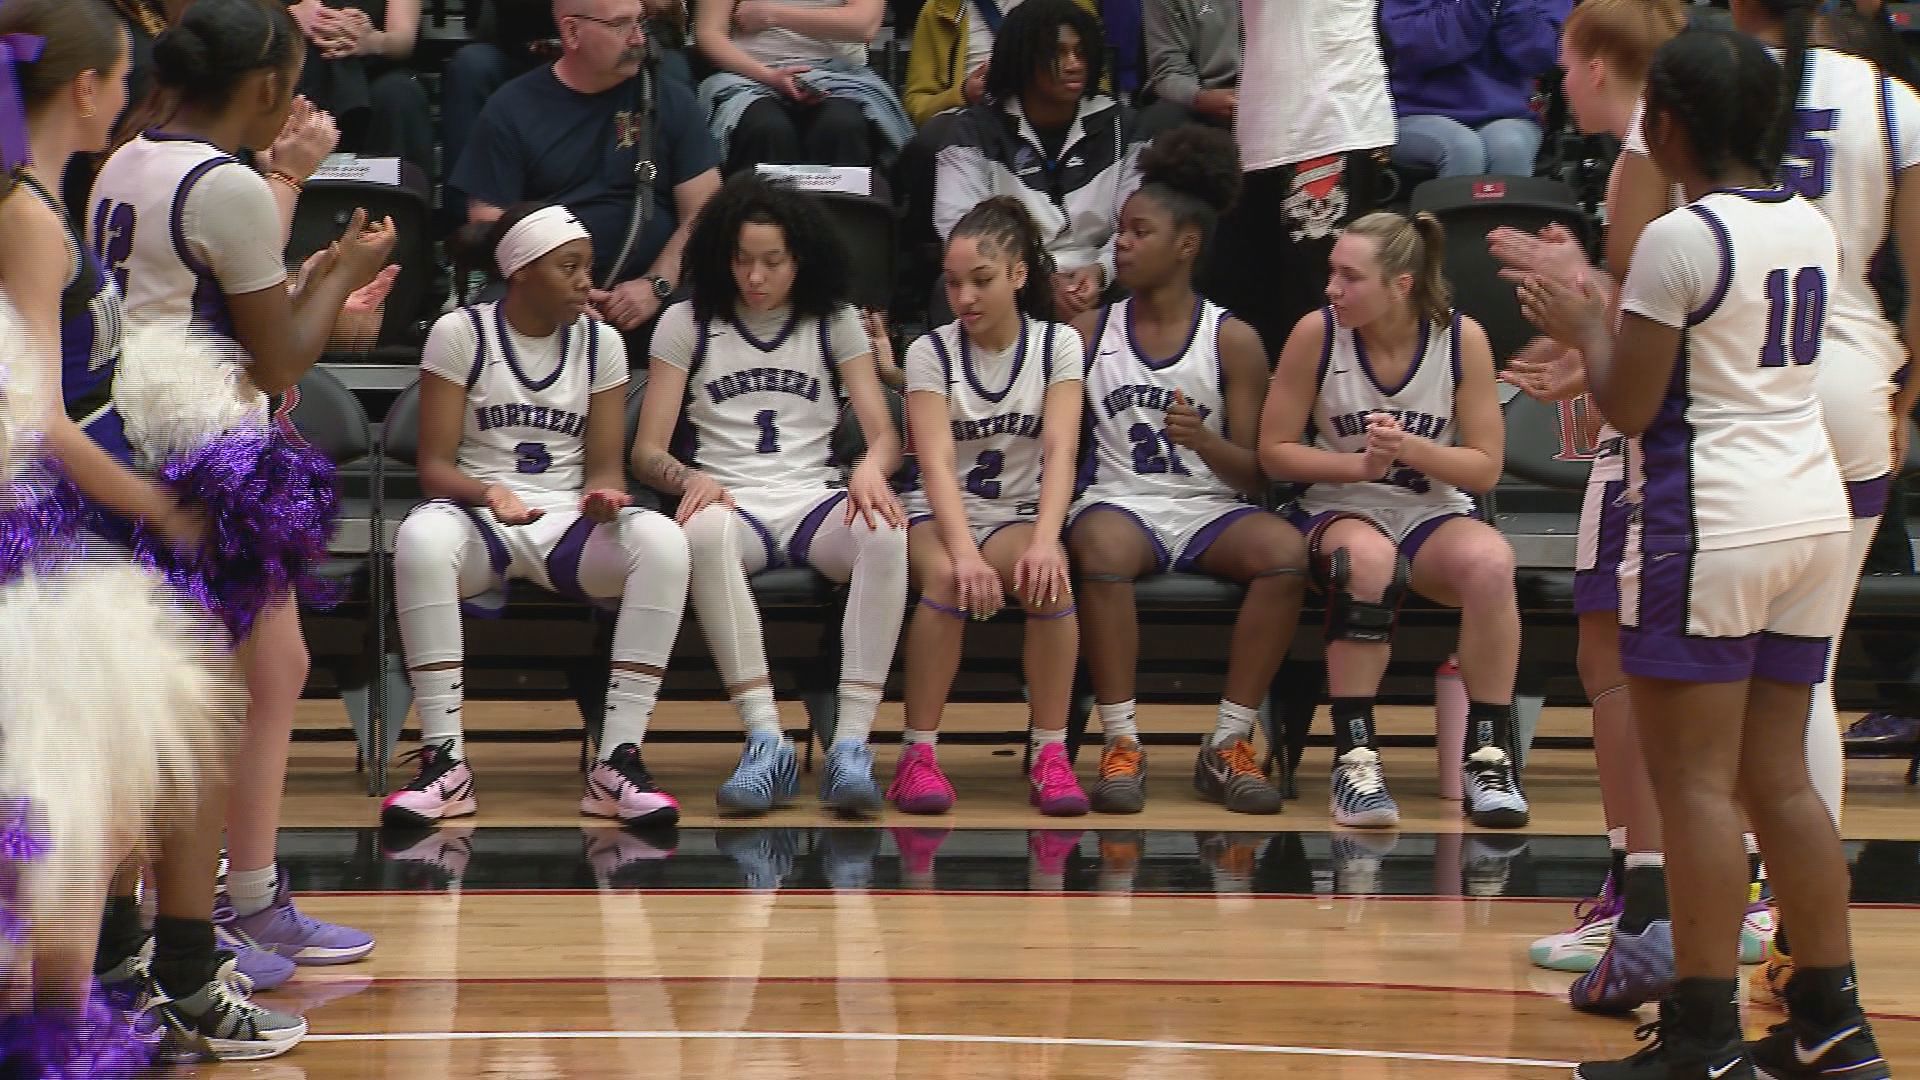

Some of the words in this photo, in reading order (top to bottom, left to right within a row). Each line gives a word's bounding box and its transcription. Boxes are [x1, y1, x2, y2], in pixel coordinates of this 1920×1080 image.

[1757, 266, 1826, 369] 10
[704, 366, 821, 405] NORTHERN
[754, 409, 781, 455] 1
[950, 412, 1044, 442] ORTHERN
[1329, 407, 1448, 441] NORERN
[1128, 423, 1192, 478] 21
[965, 449, 1005, 501] 2
